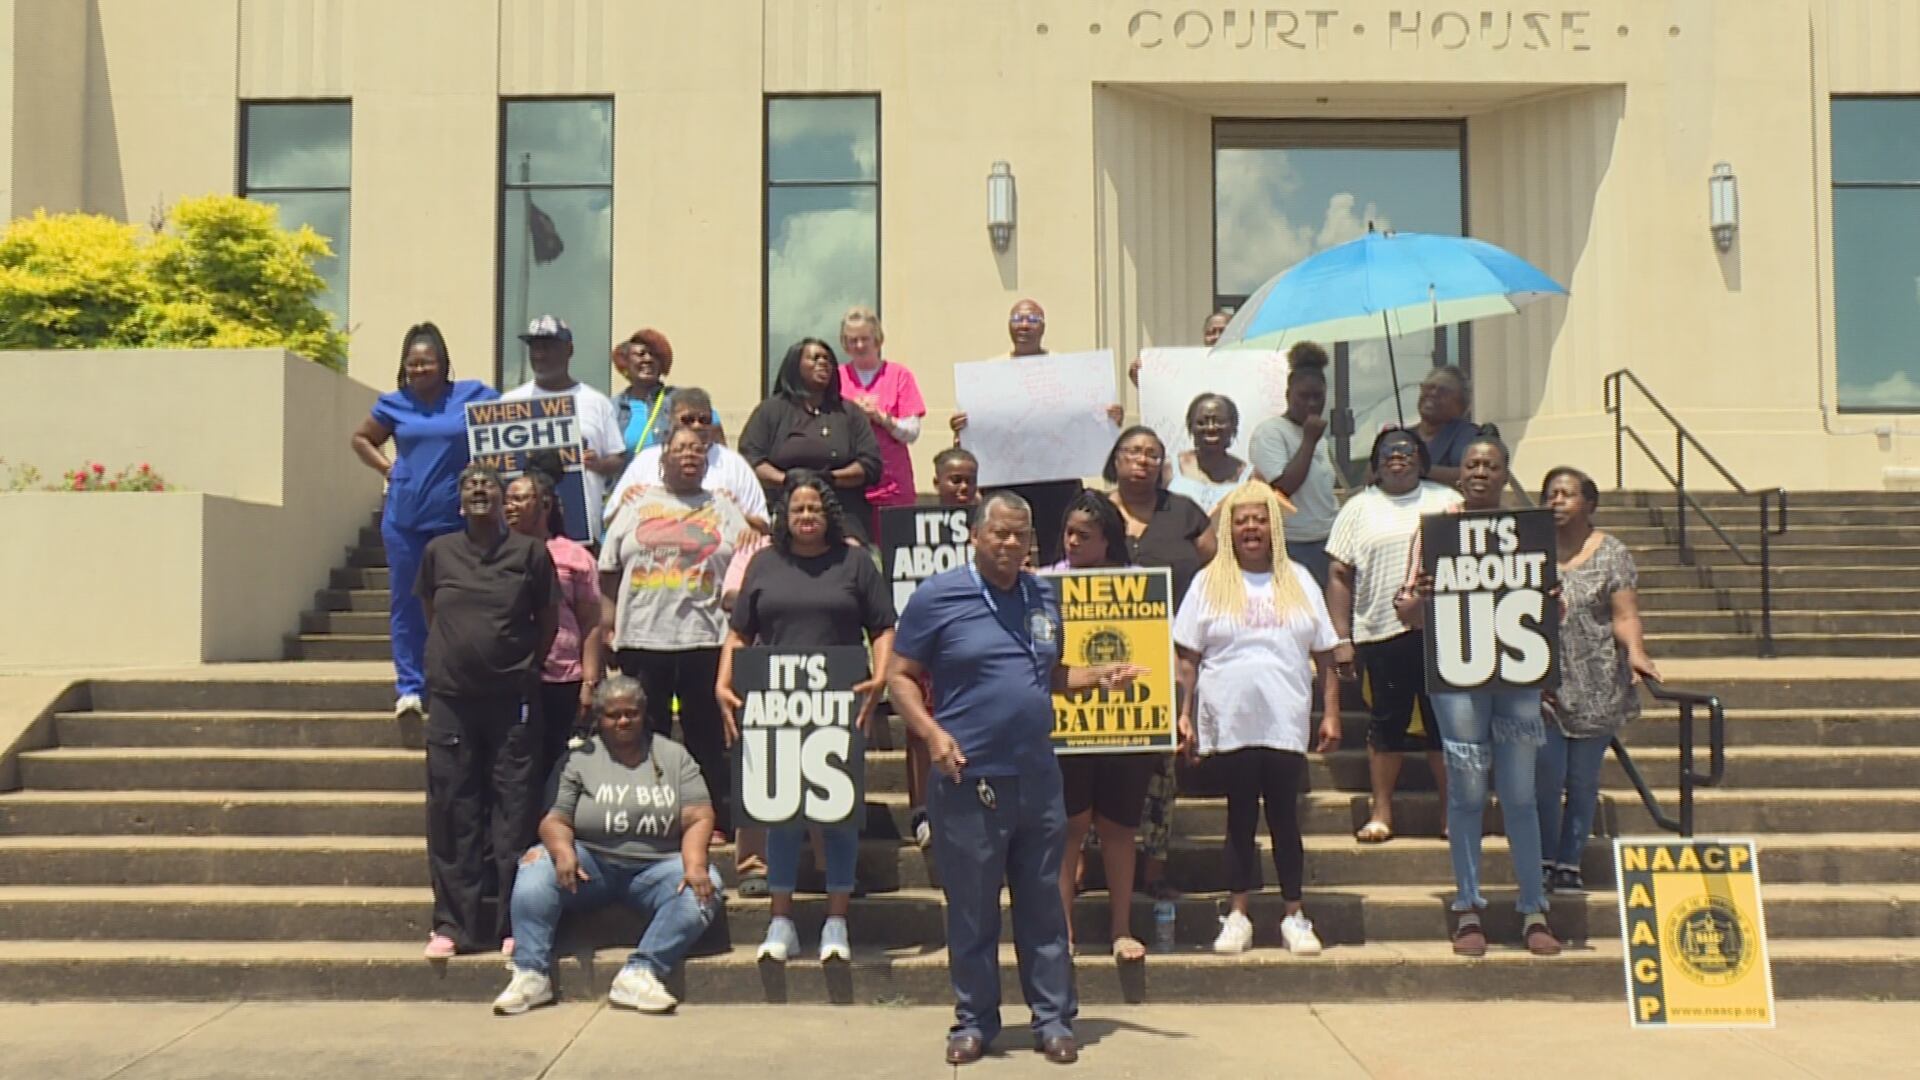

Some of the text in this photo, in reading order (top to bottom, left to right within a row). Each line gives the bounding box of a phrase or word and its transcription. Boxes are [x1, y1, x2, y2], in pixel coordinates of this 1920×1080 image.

[1127, 9, 1592, 51] COURT HOUSE
[472, 395, 574, 425] WHEN WE
[474, 419, 573, 451] FIGHT
[915, 510, 970, 545] IT'S
[1459, 516, 1519, 554] IT'S
[1061, 575, 1148, 603] NEW
[1434, 551, 1547, 592] ABOUT
[1434, 588, 1550, 686] US
[769, 653, 828, 690] IT'S
[743, 690, 855, 727] ABOUT
[1052, 704, 1169, 732] BATTLE
[742, 726, 855, 823] US
[595, 783, 676, 808] MY BED
[605, 810, 674, 837] IS MY
[1623, 845, 1750, 871] NAACP
